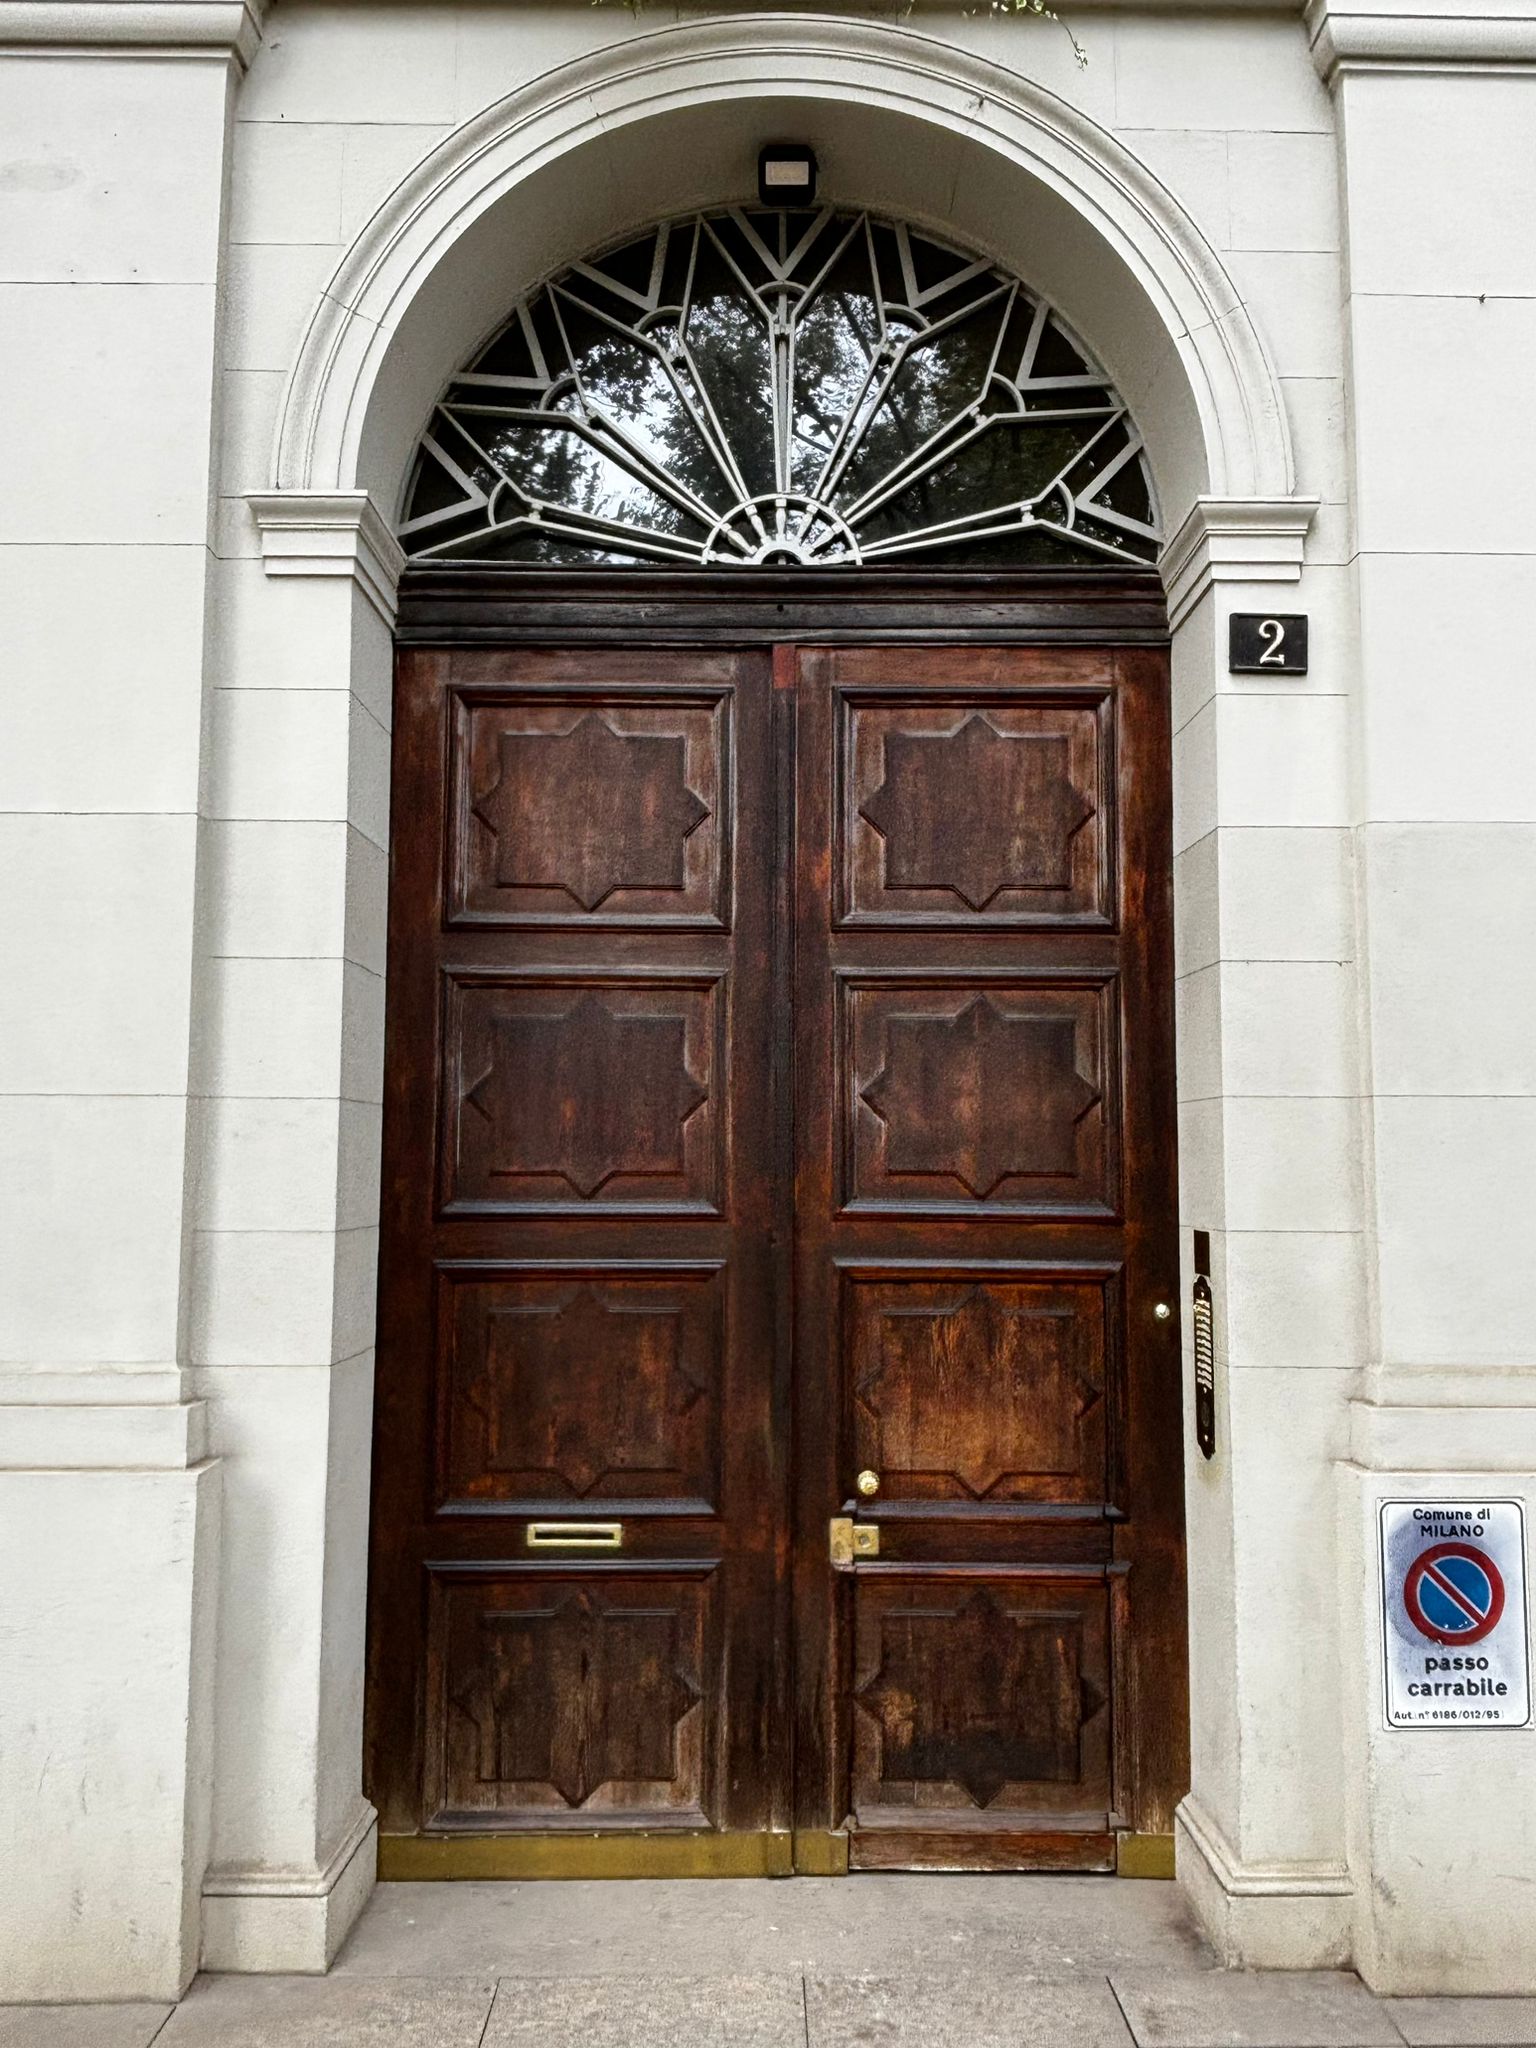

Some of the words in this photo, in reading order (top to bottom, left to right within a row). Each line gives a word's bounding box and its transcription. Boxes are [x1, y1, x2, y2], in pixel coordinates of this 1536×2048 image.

[1259, 619, 1285, 665] 2
[1413, 1508, 1472, 1520] Comune
[1477, 1508, 1490, 1520] di
[1421, 1525, 1484, 1537] MILANO
[1425, 1657, 1489, 1674] passo
[1408, 1678, 1507, 1696] carrabile
[1432, 1710, 1500, 1720] 6186/012/95
